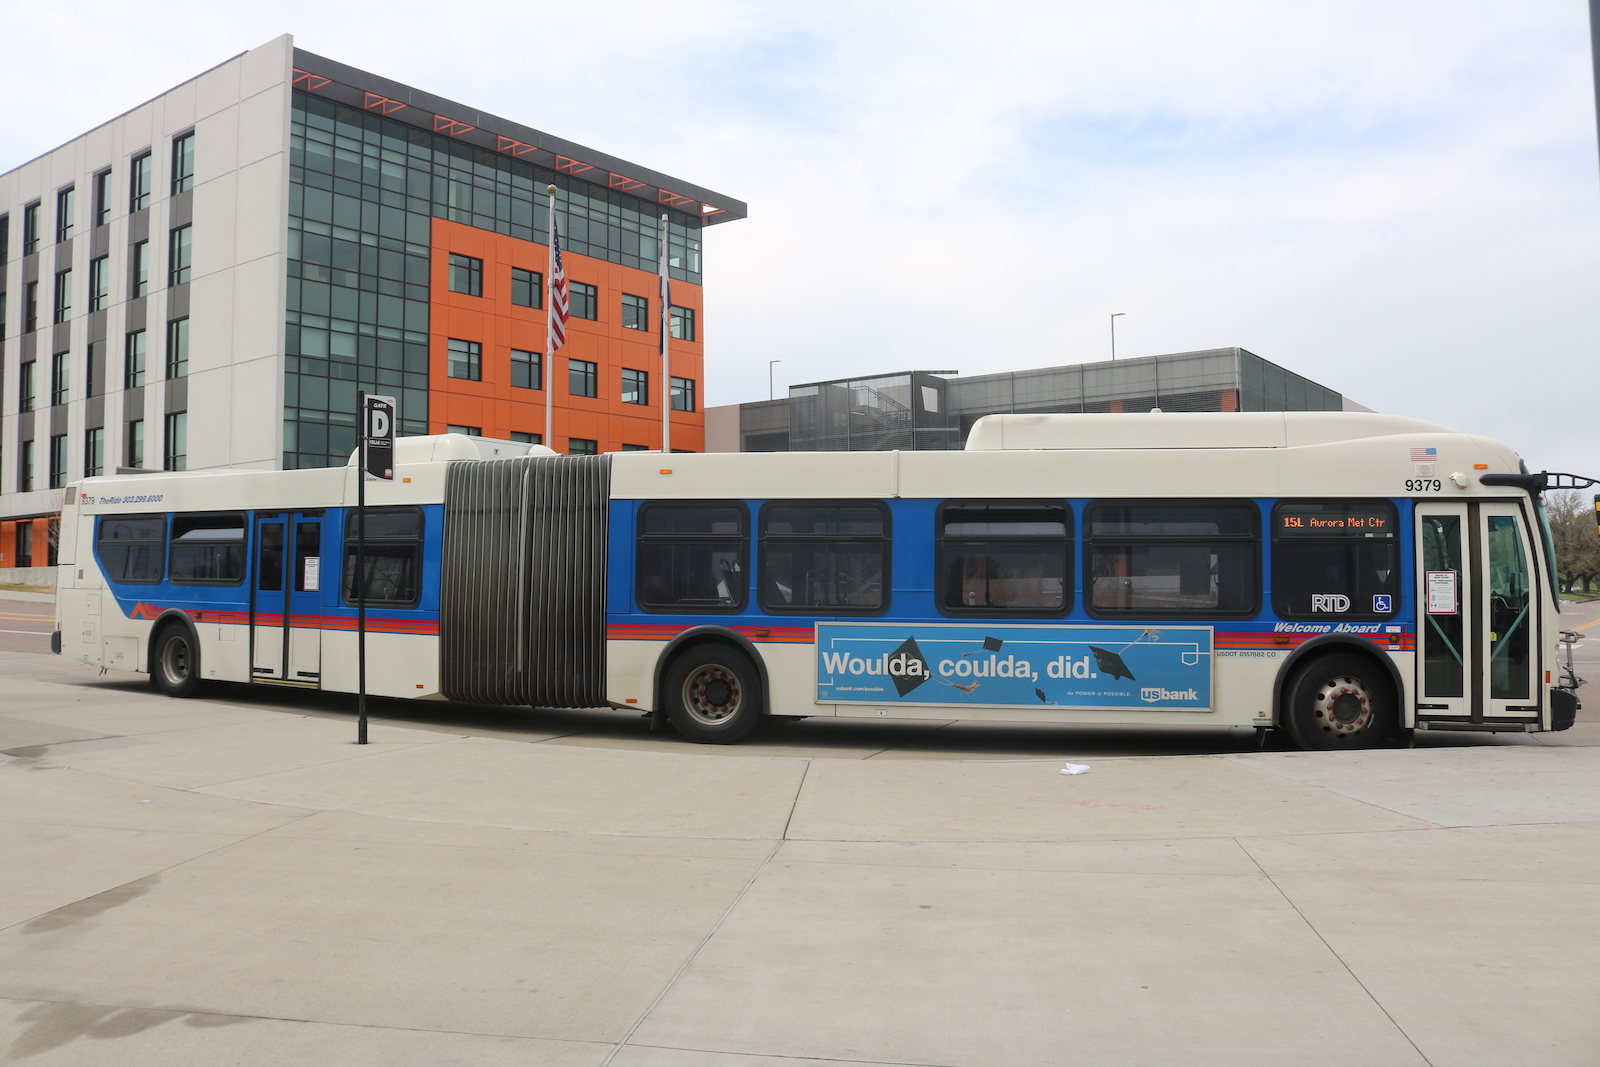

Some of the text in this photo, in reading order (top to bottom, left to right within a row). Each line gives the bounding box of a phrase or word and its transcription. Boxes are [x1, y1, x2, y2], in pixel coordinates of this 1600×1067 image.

[372, 410, 389, 437] D
[1405, 479, 1442, 492] 9379
[81, 494, 163, 505] 9379 TheRide 303.299.6000
[1284, 517, 1386, 528] 15L Aurora Met Ctr
[1311, 594, 1350, 613] RTD
[1273, 622, 1381, 633] Welcome Aboard
[822, 651, 1097, 683] Woulda, coulda, did.
